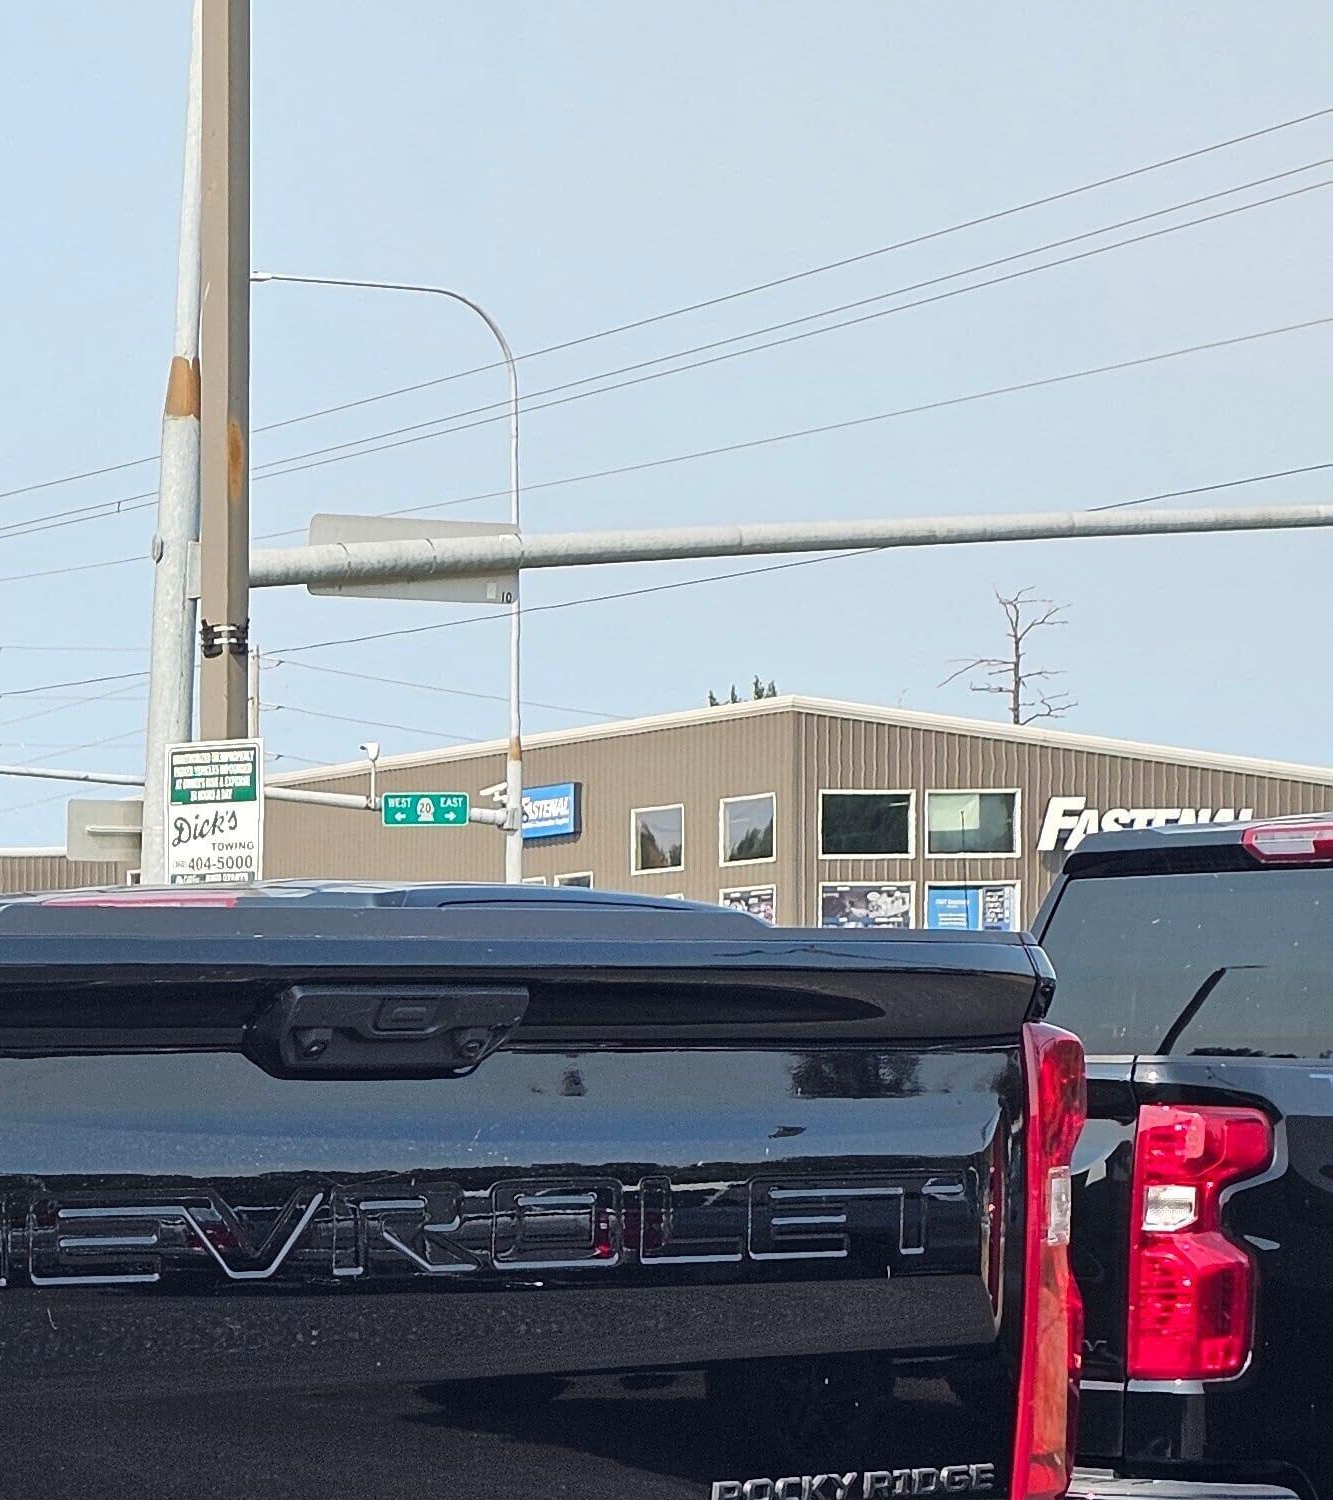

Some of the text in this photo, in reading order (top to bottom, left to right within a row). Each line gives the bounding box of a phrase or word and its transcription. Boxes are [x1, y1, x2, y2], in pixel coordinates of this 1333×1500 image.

[387, 797, 413, 808] WEST
[439, 796, 464, 807] EAST
[419, 803, 432, 813] 20
[172, 810, 238, 847] Dick's
[211, 841, 255, 852] TOWING
[188, 855, 253, 871] 404-5000
[863, 1463, 995, 1499] RIDGE
